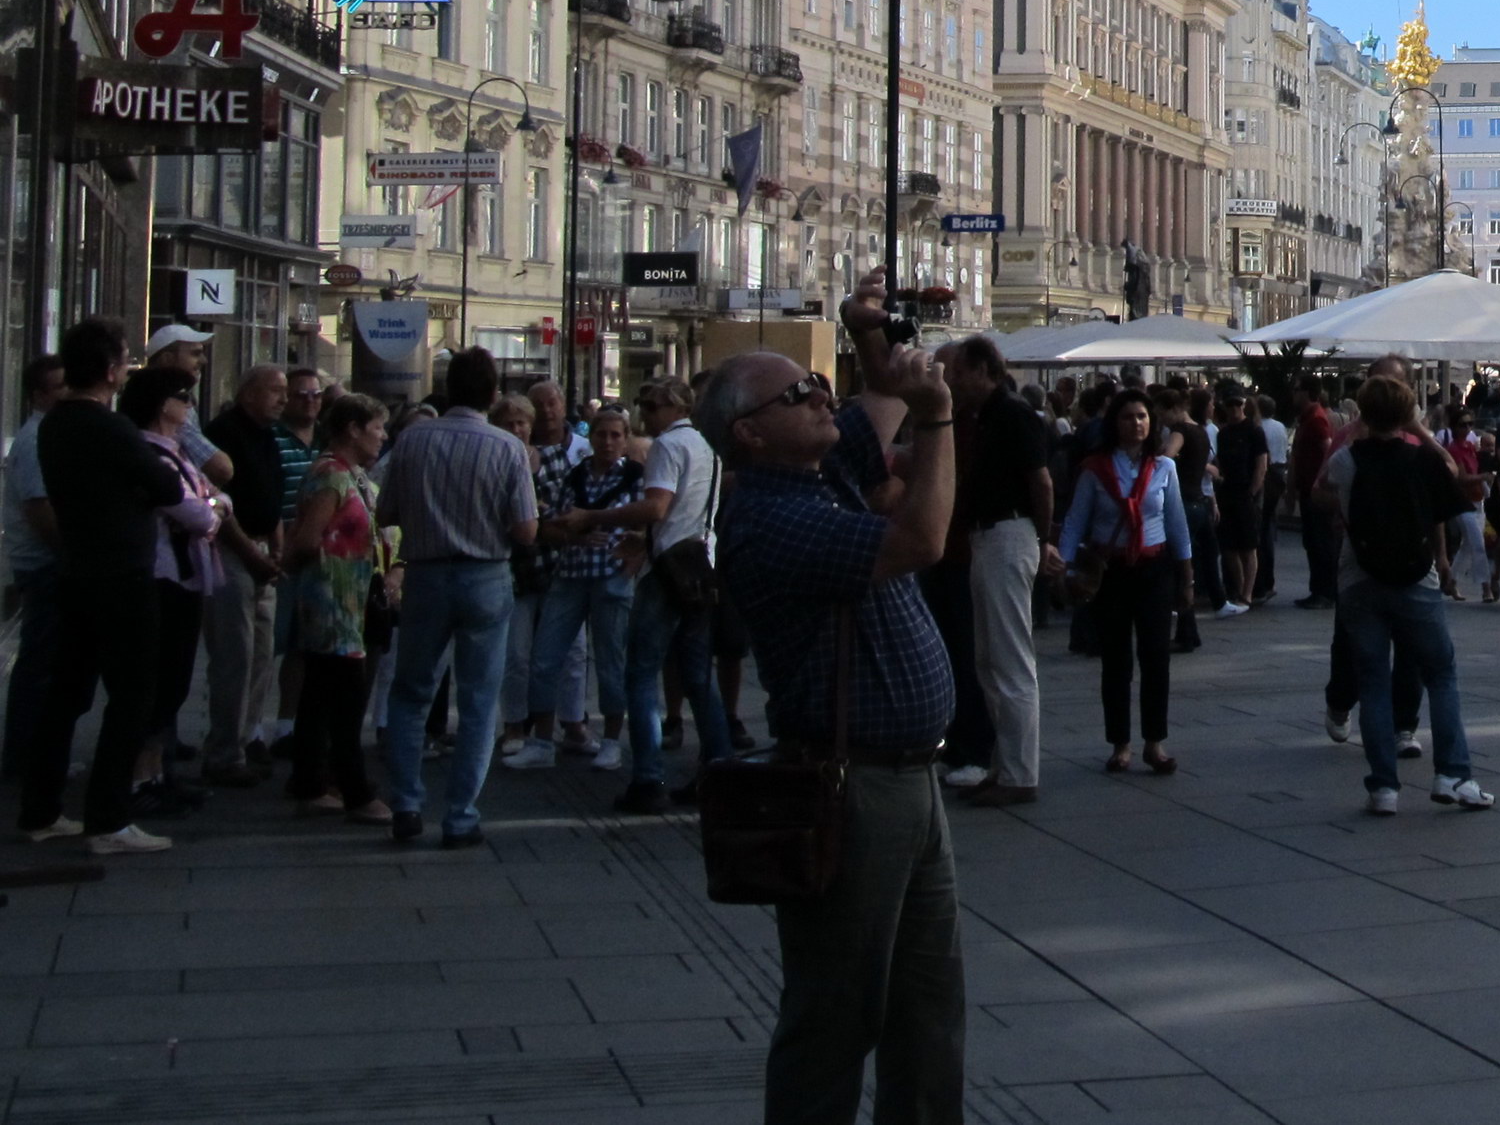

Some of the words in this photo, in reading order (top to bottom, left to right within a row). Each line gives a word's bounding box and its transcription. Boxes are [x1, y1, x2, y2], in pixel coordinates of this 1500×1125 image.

[92, 77, 250, 124] APOTHEKE
[388, 158, 427, 166] GALERIE
[378, 171, 446, 180] SINDBADS
[951, 217, 998, 230] Berlitz
[377, 318, 407, 329] Trink
[368, 329, 417, 340] Wasser!
